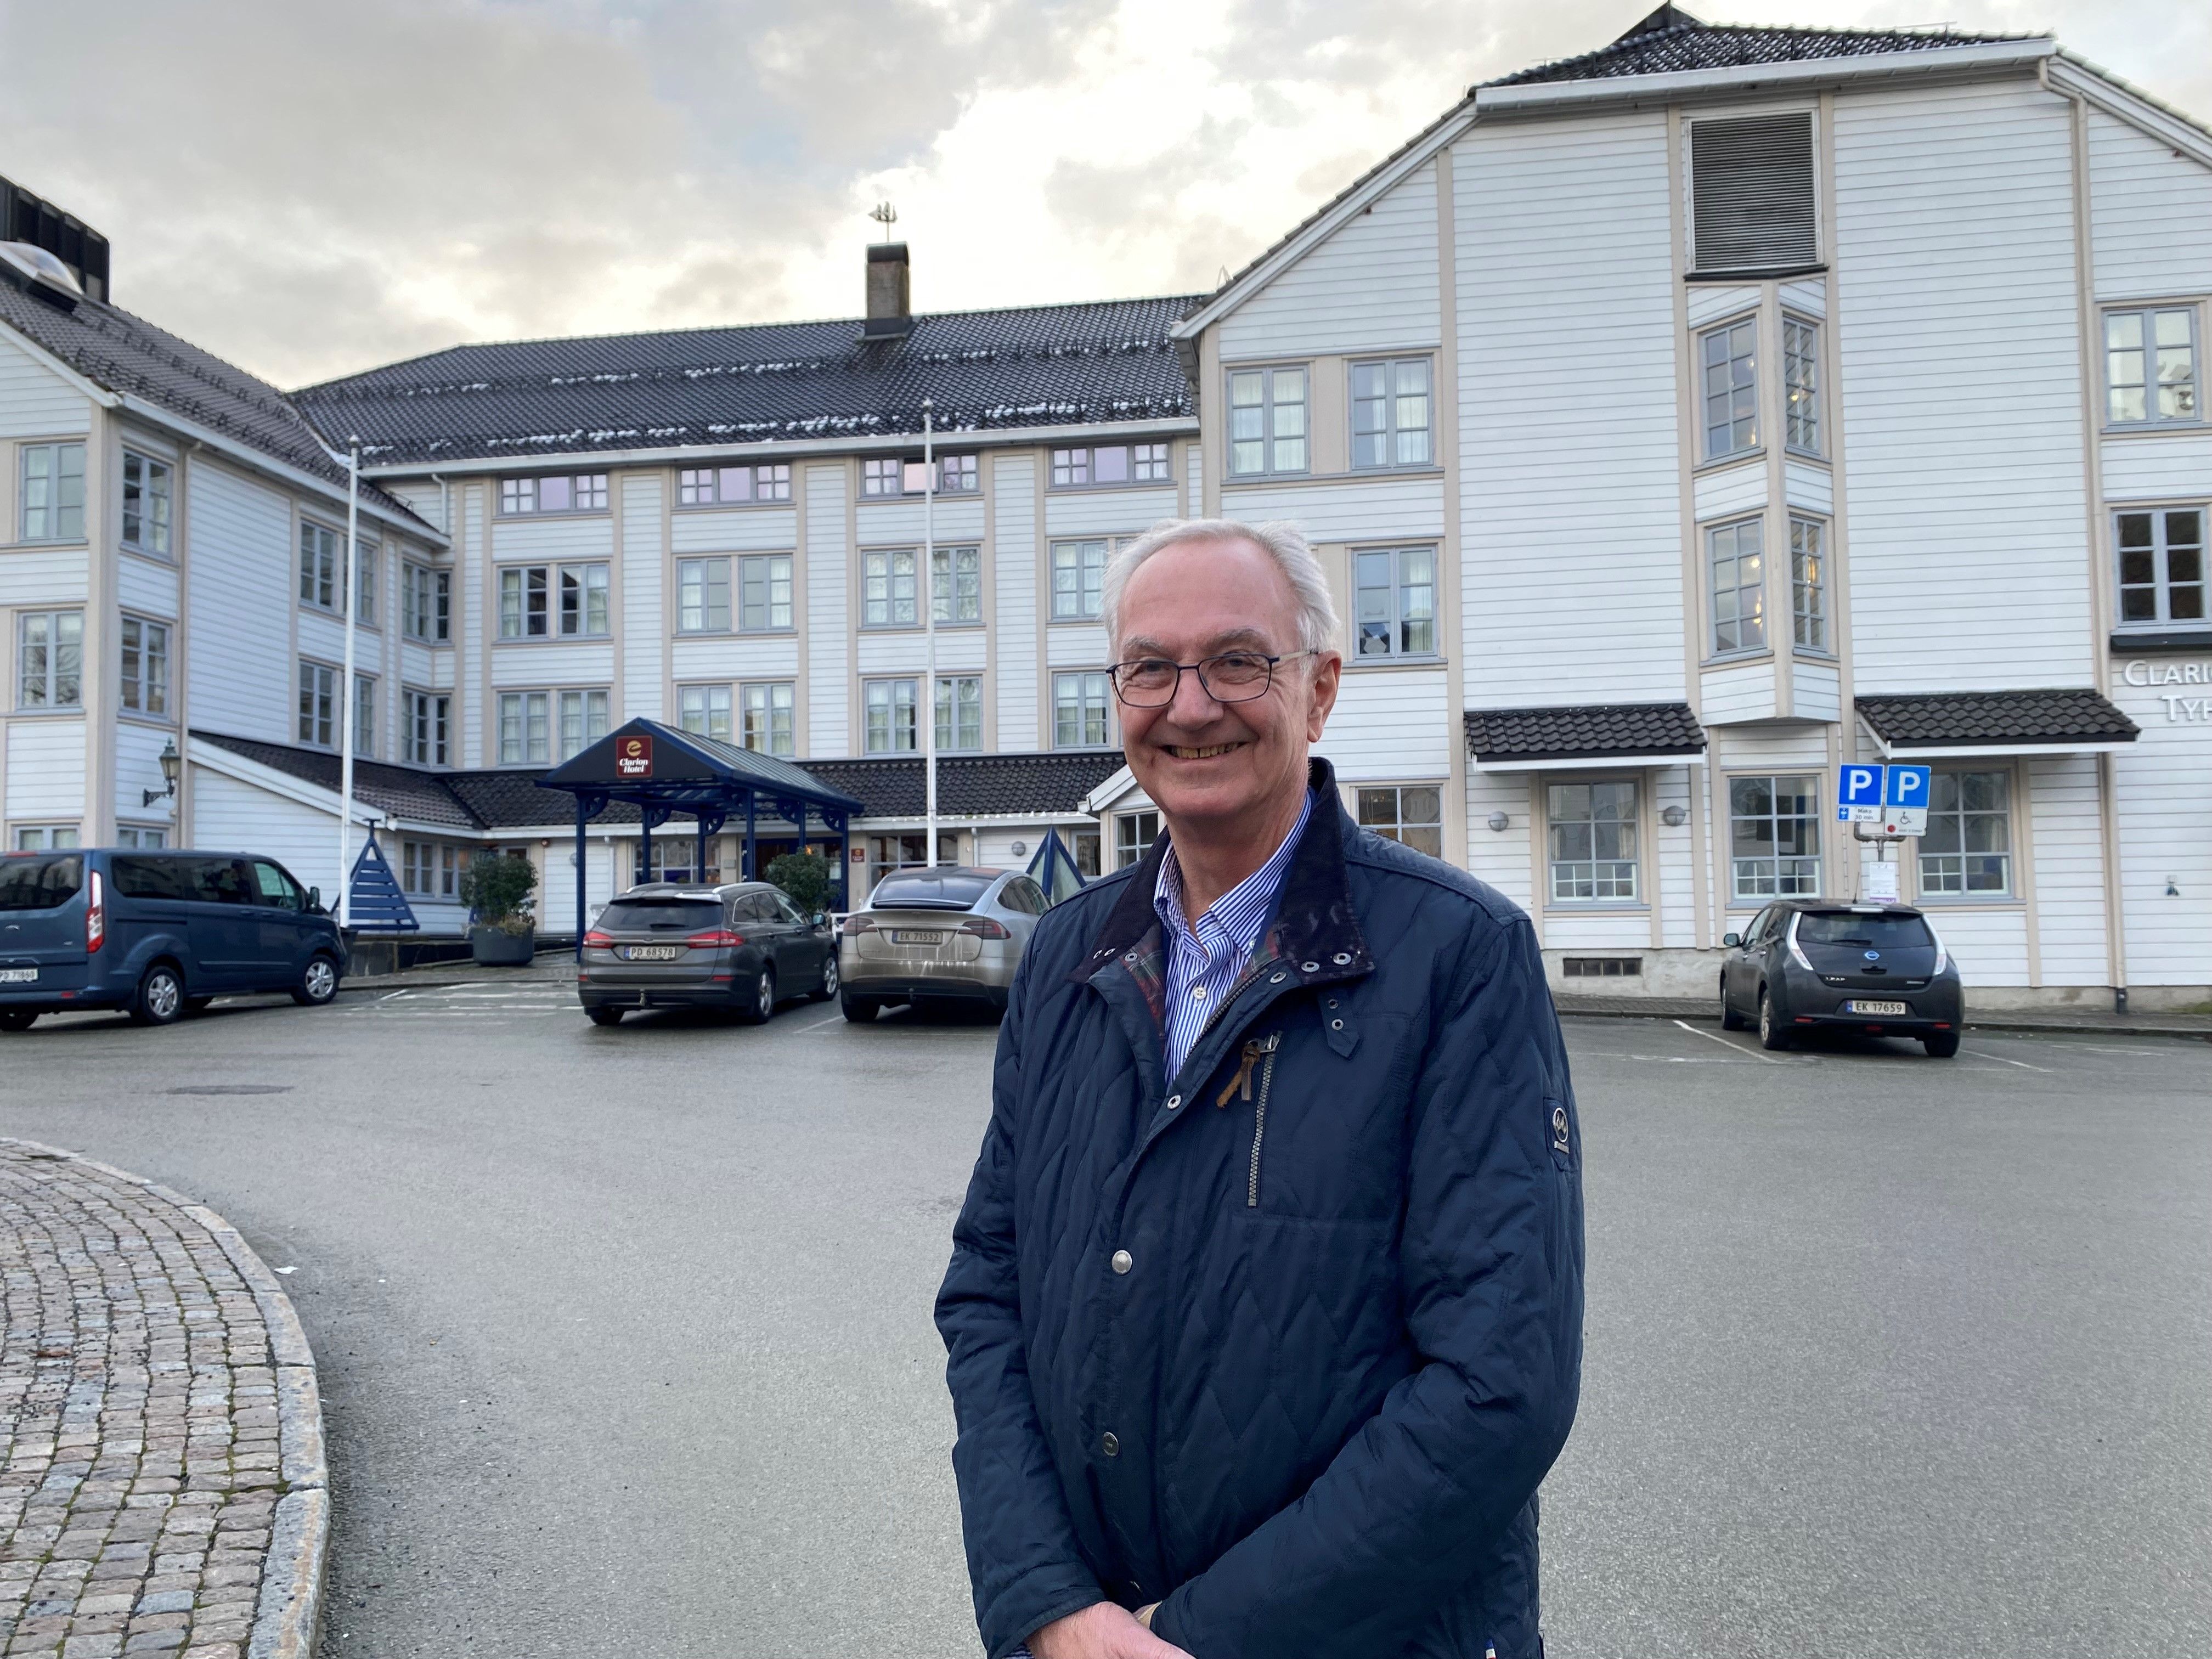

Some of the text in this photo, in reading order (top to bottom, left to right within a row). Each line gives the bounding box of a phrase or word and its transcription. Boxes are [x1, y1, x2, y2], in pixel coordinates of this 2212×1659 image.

[2125, 660, 2212, 686] CLARI
[619, 758, 648, 766] Clarion
[624, 765, 645, 774] Hotel
[1848, 769, 1873, 800] P
[1898, 771, 1921, 802] P
[914, 933, 939, 941] 71552
[631, 947, 673, 956] PD 68578
[1856, 1003, 1903, 1013] EK 17659
